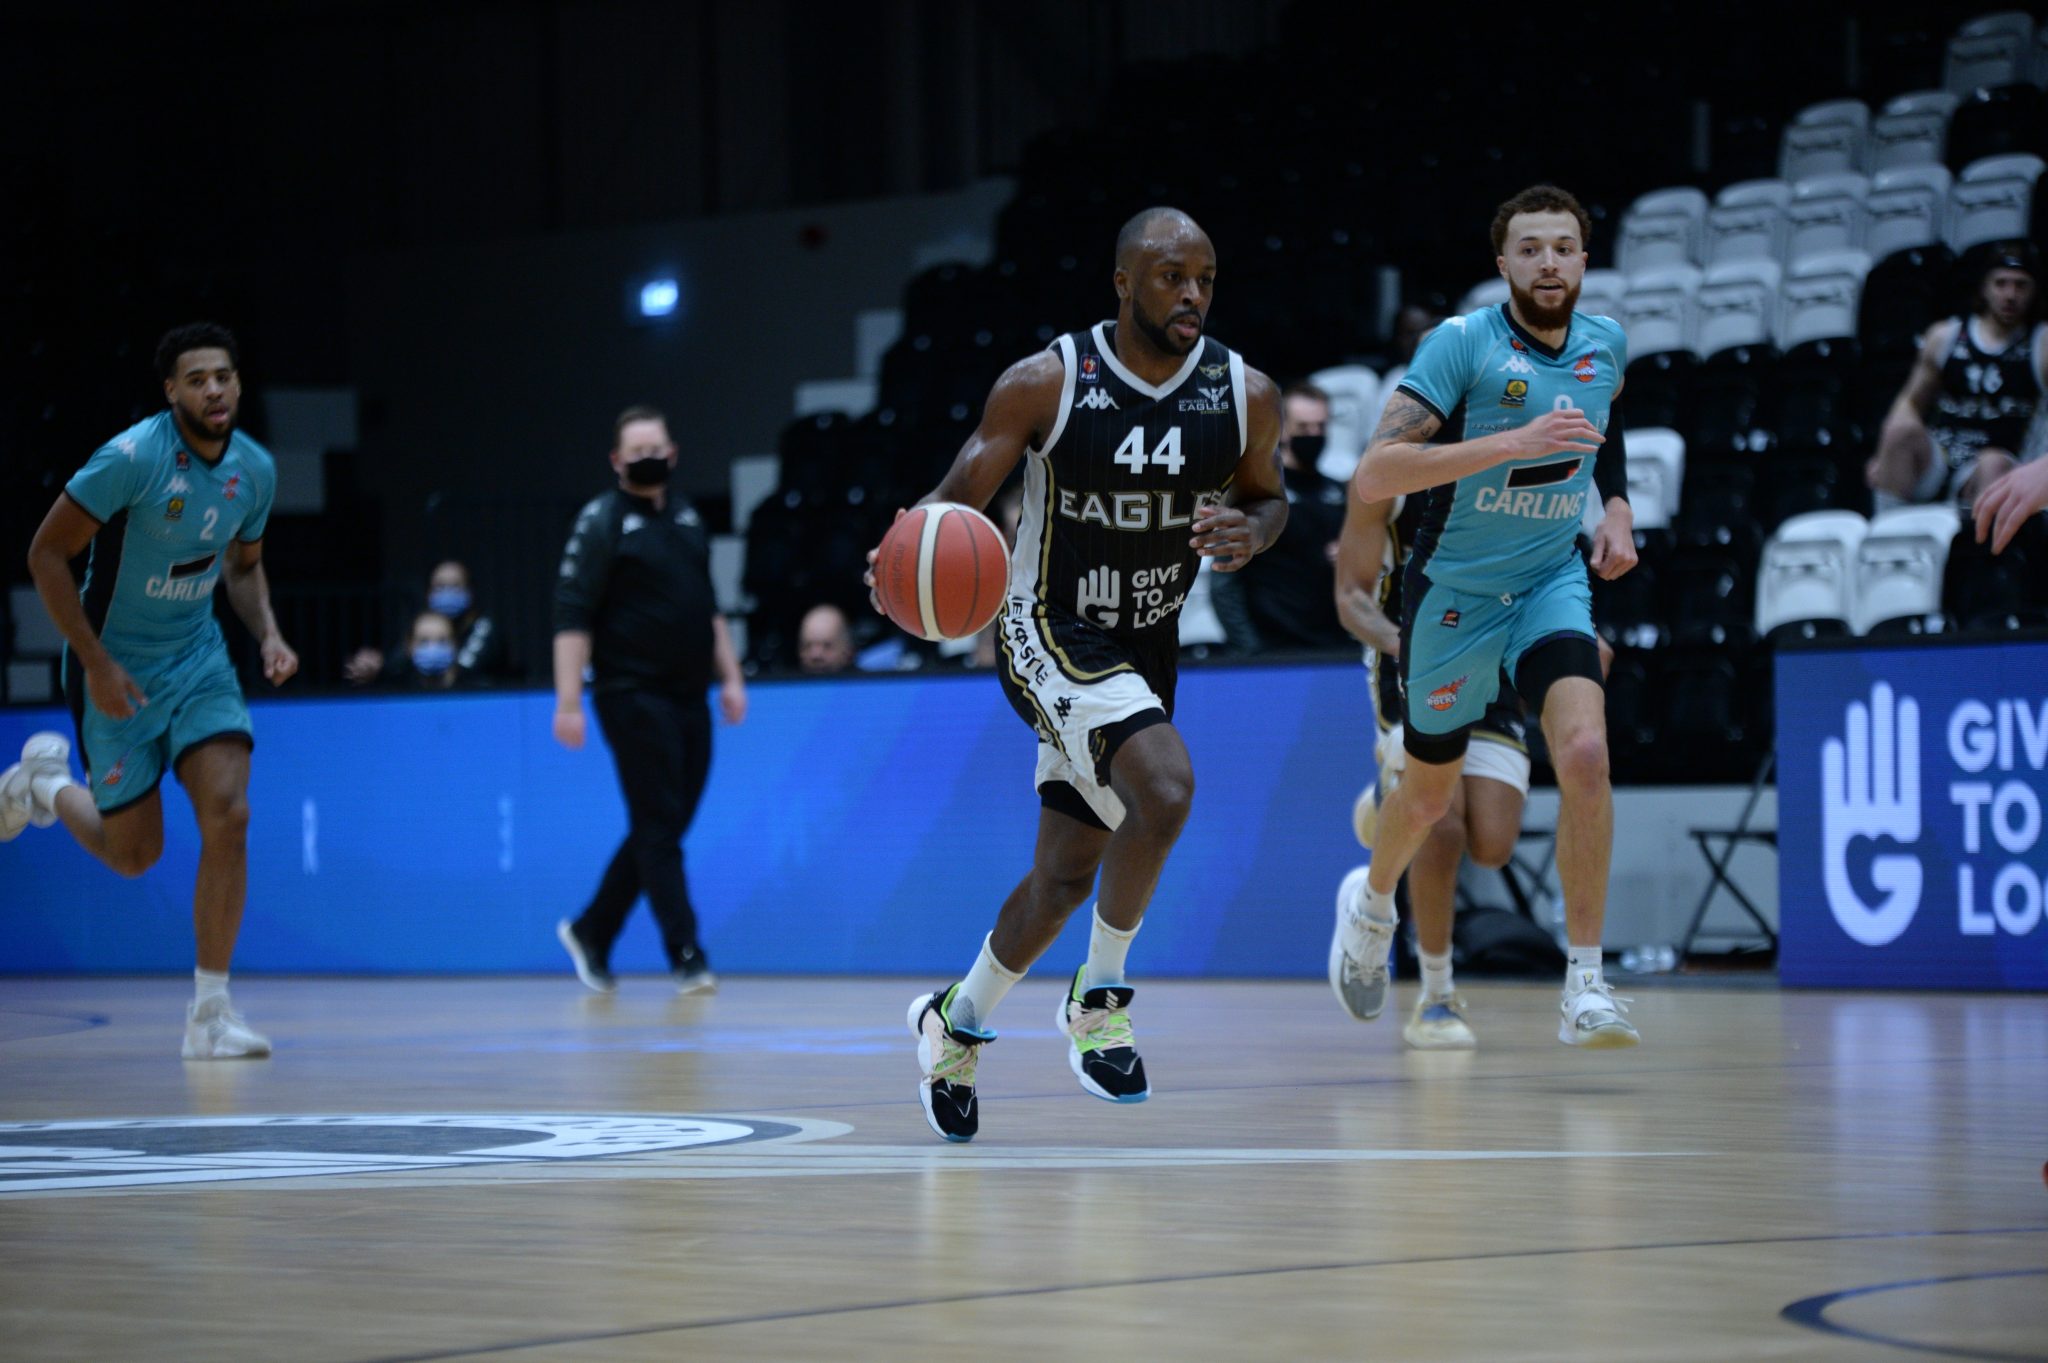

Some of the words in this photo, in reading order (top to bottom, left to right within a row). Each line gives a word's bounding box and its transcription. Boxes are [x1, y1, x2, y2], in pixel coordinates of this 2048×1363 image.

[1179, 401, 1229, 411] EAGLES
[1114, 426, 1185, 475] 44
[199, 506, 219, 541] 2
[1132, 563, 1182, 589] GIVE
[1132, 588, 1164, 610] TO
[1950, 780, 2042, 853] TO
[1959, 862, 2048, 936] LO
